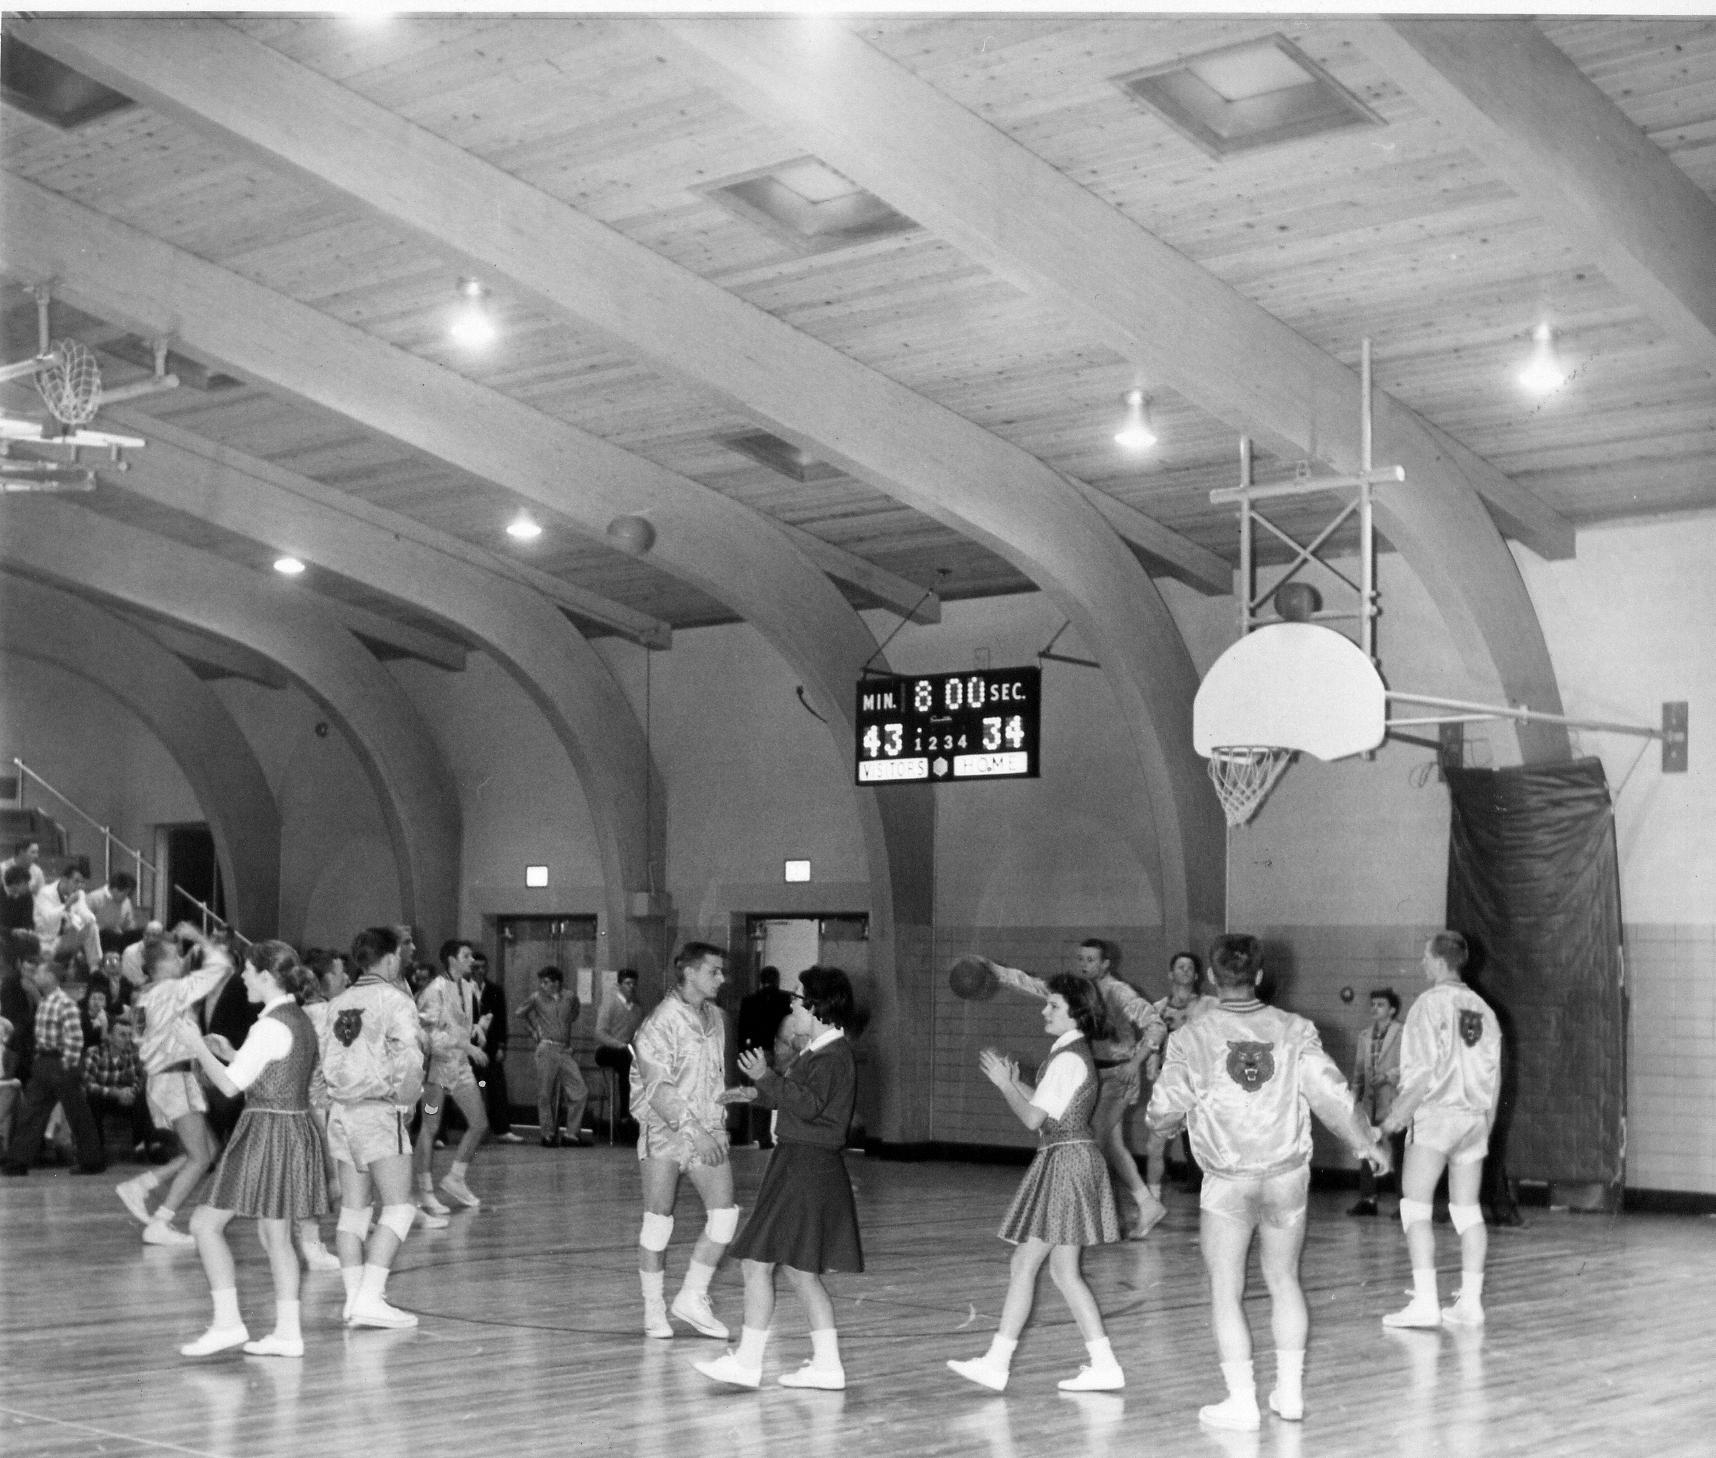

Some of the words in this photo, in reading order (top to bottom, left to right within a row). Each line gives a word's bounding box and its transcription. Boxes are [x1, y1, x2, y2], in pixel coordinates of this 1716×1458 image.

[863, 692, 897, 711] MIN.
[914, 680, 932, 712] 8
[945, 676, 985, 710] 00
[990, 682, 1026, 701] SEC.
[863, 723, 903, 758] 43
[915, 737, 922, 751] 1
[928, 736, 938, 750] 2
[943, 735, 954, 750] 3
[957, 734, 968, 749] 4
[982, 715, 1025, 750] 34
[863, 760, 924, 779] VISITORS
[962, 754, 1018, 774] HOME
